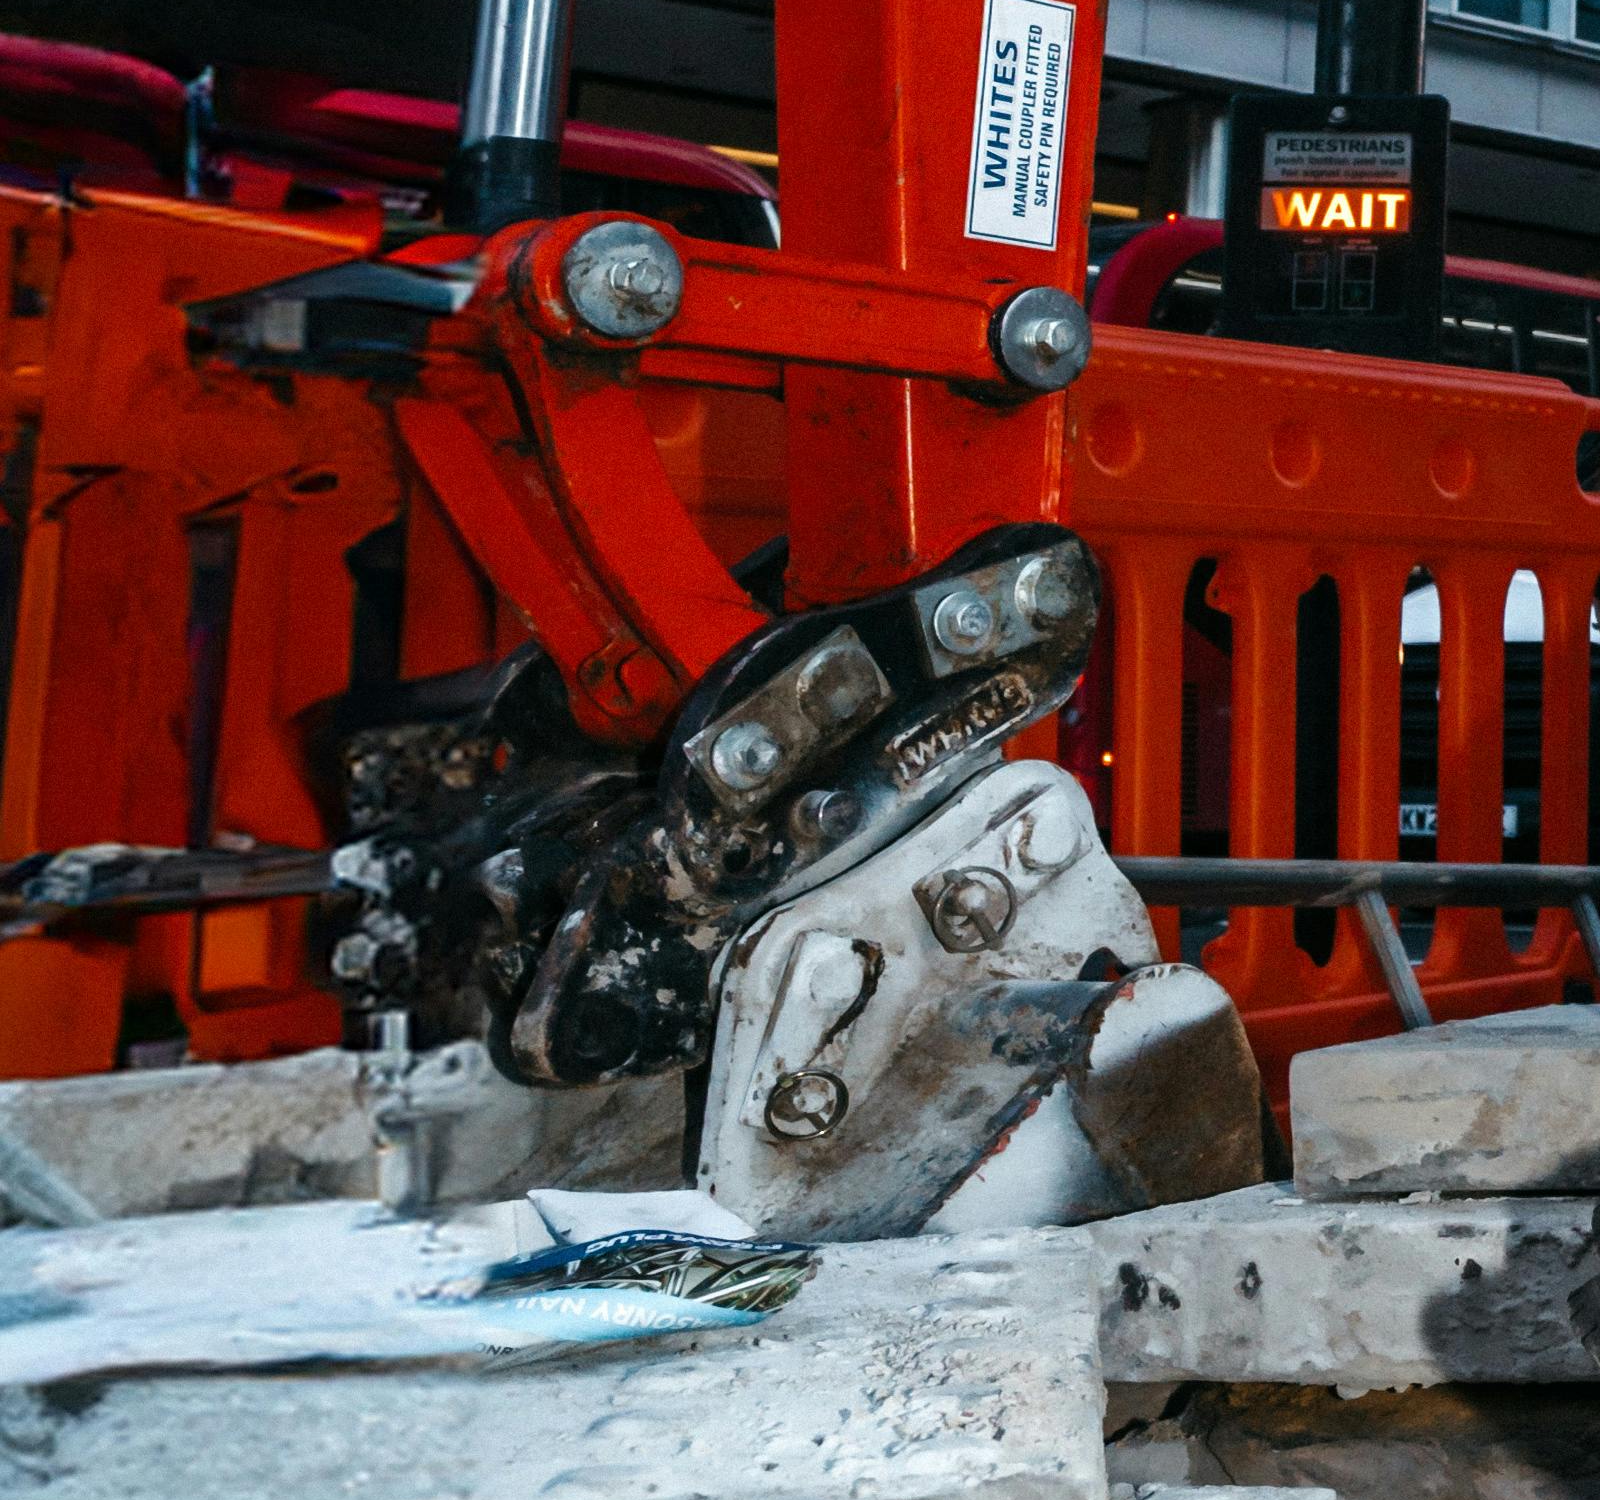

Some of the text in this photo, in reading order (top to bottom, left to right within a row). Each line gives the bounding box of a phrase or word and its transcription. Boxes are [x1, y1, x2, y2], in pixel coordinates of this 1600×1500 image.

[983, 38, 1019, 189] WHITES
[1012, 24, 1043, 218] MANUAL COUPLER FITTED
[1034, 43, 1061, 208] SAFETY PIN REQUIRED
[1276, 138, 1405, 153] PEDESTRIANS
[1271, 191, 1406, 229] WAIT
[585, 1232, 754, 1255] RAWLPLUG
